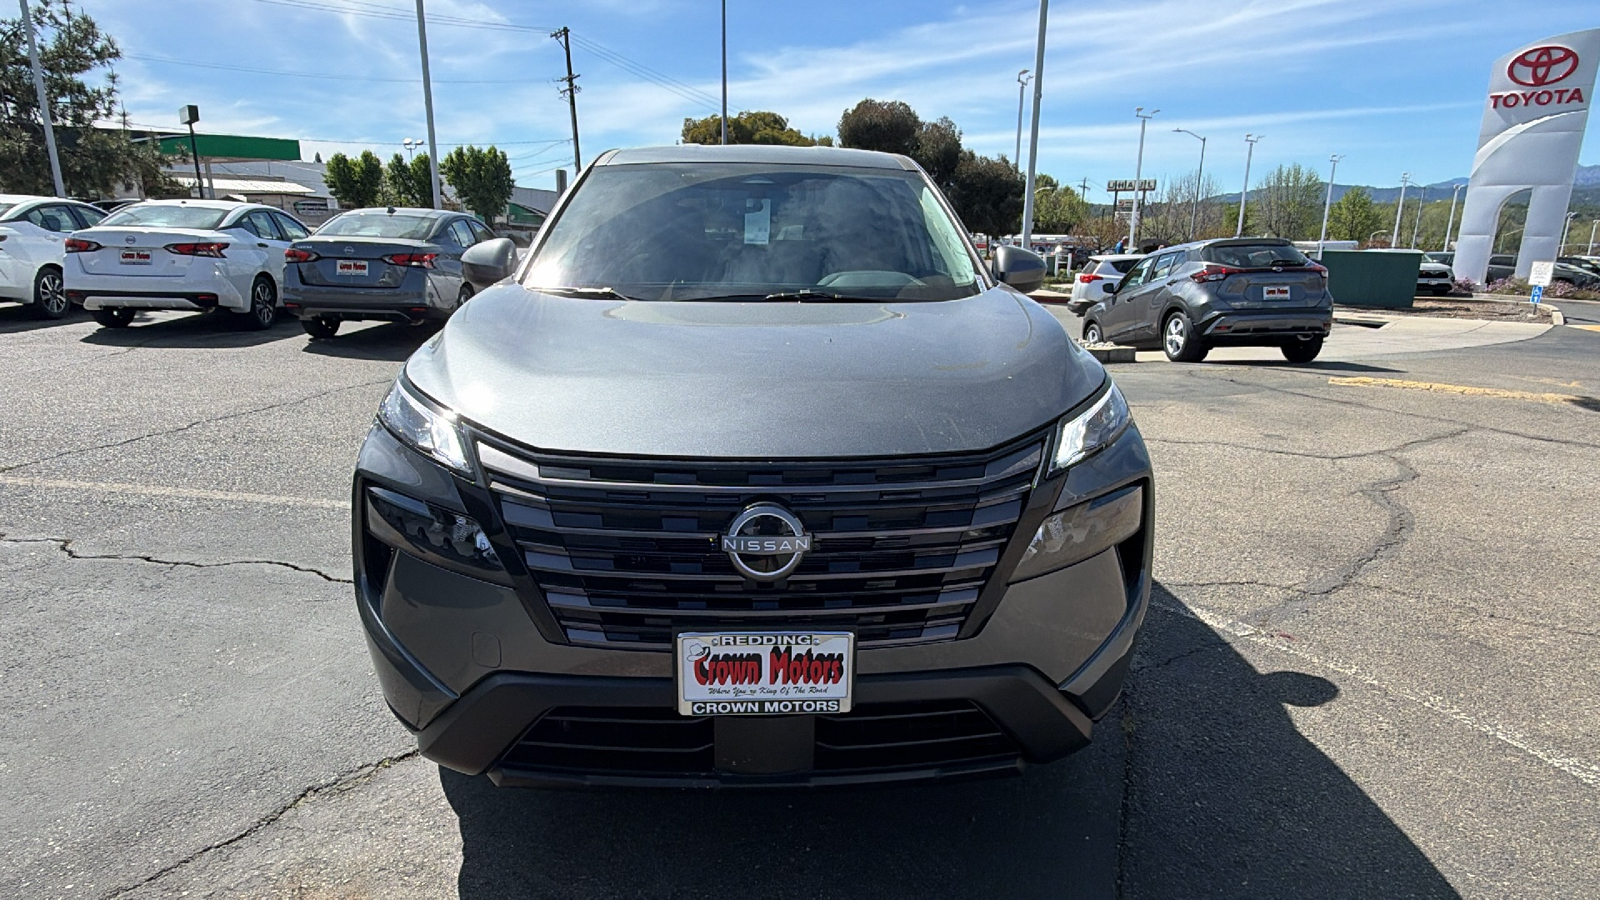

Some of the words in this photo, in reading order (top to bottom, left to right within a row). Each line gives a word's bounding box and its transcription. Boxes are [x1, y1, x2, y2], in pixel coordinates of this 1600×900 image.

[1490, 88, 1583, 108] TOYOTA
[724, 538, 808, 551] NISSAN
[721, 636, 811, 646] REDDING
[693, 647, 762, 686] Crown
[769, 646, 844, 685] Motors
[708, 686, 731, 695] Where
[758, 686, 777, 695] King
[780, 686, 791, 695] Of
[792, 685, 806, 694] The
[808, 685, 829, 694] Road
[693, 702, 759, 714] CROWN
[764, 701, 839, 713] MOTORS
